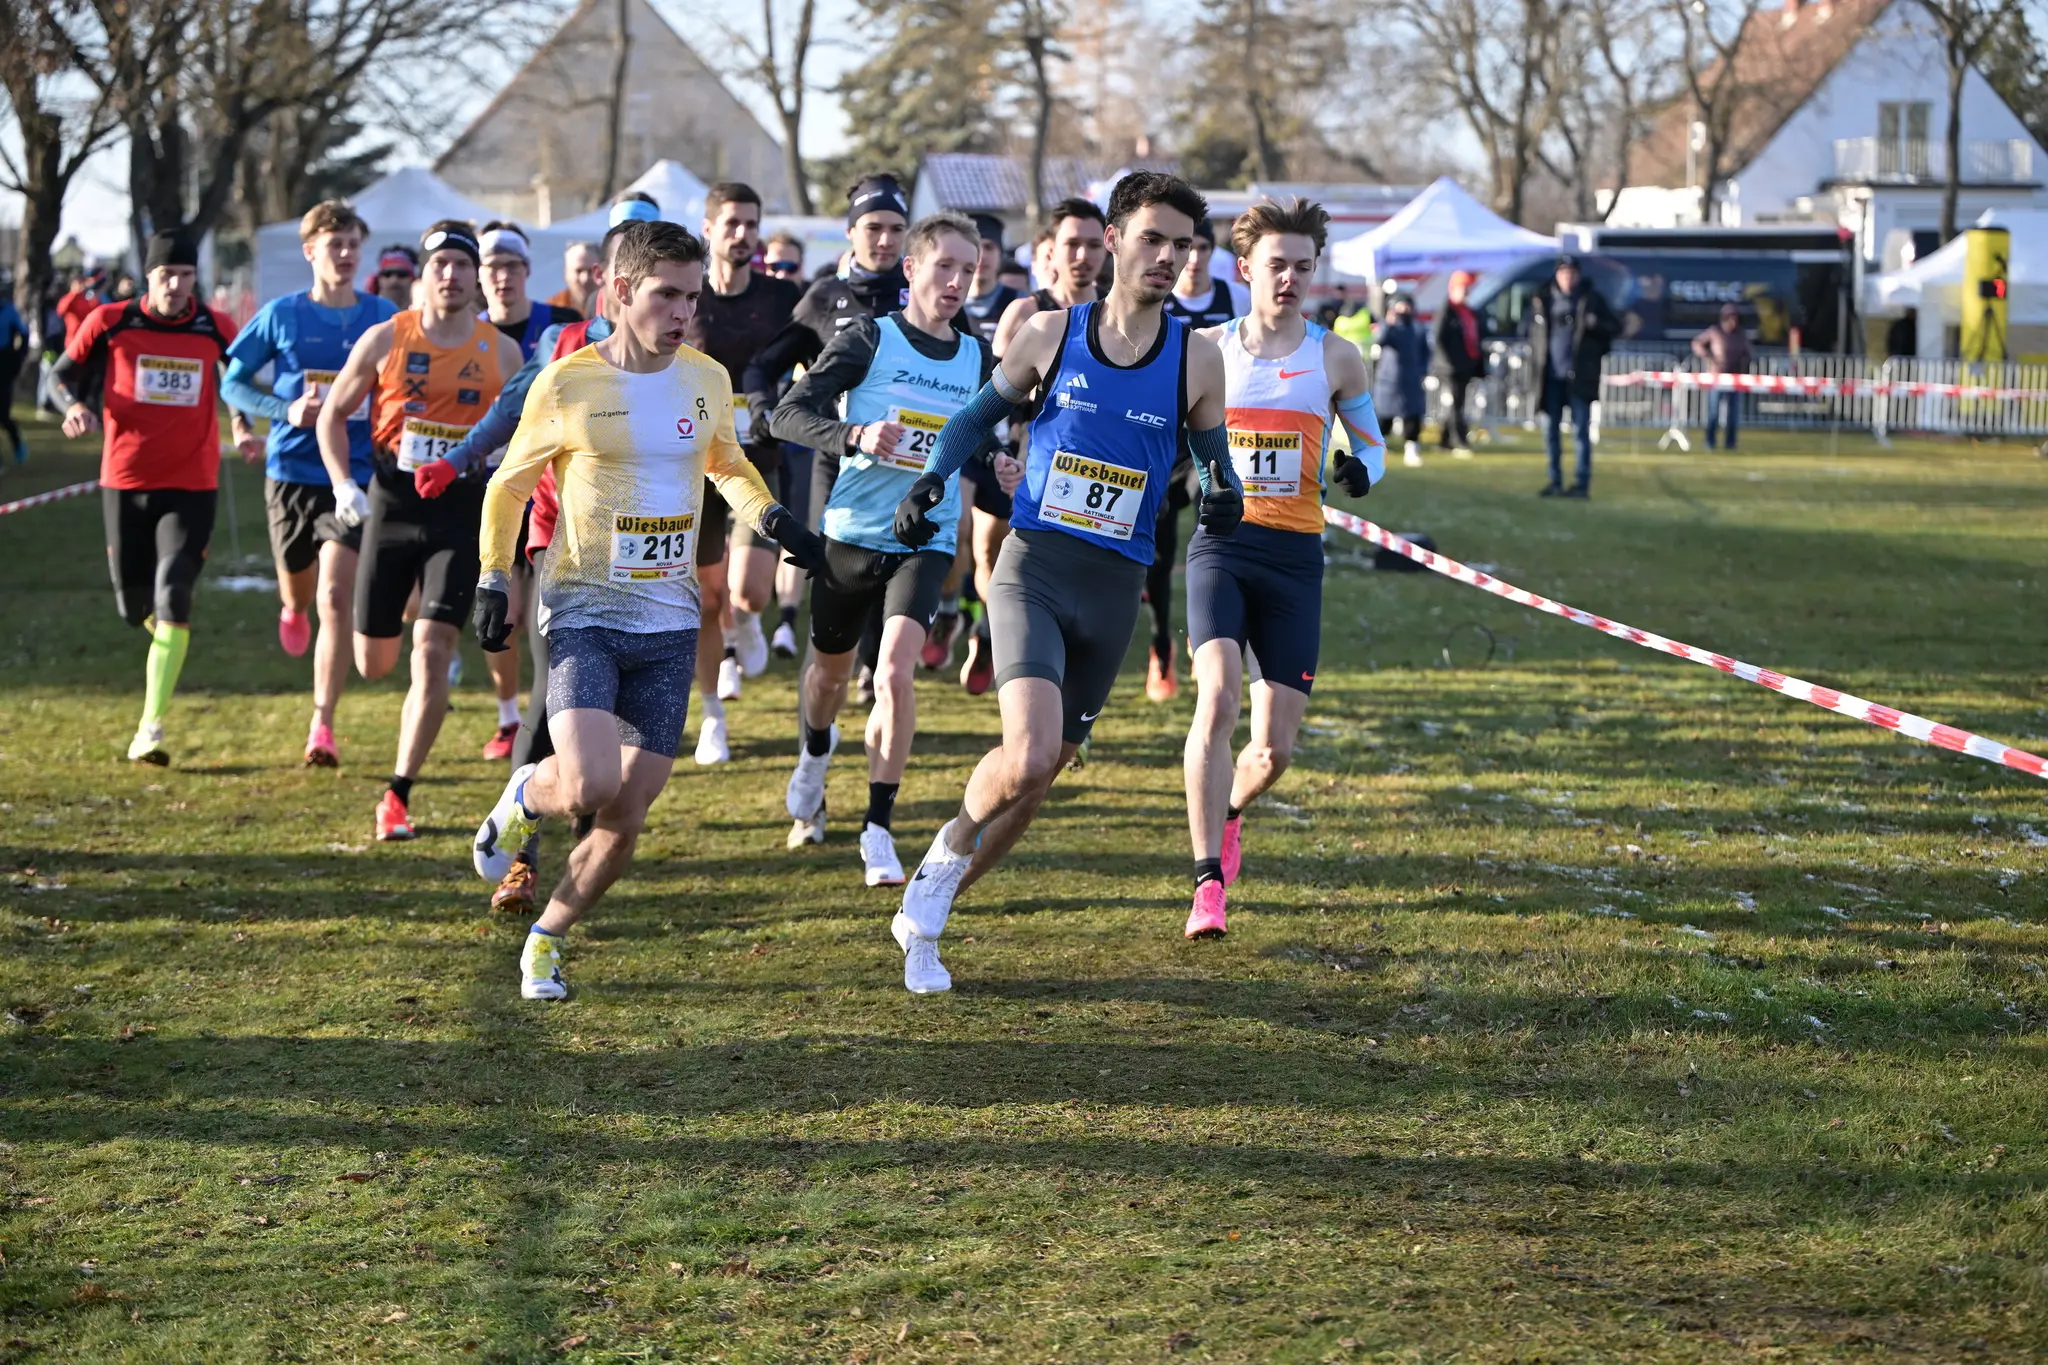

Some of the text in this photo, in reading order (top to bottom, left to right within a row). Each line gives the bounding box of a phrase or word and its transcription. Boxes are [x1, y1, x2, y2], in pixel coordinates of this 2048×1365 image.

[158, 371, 191, 390] 383
[892, 370, 972, 401] Zehnkampf
[1070, 399, 1098, 409] BUSINESS
[1055, 455, 1146, 488] Wiesbauer
[1250, 451, 1277, 474] 11
[1086, 482, 1123, 512] 87
[616, 514, 694, 532] Wiesbauer
[1083, 509, 1115, 521] RATTINGER
[643, 533, 685, 560] 213
